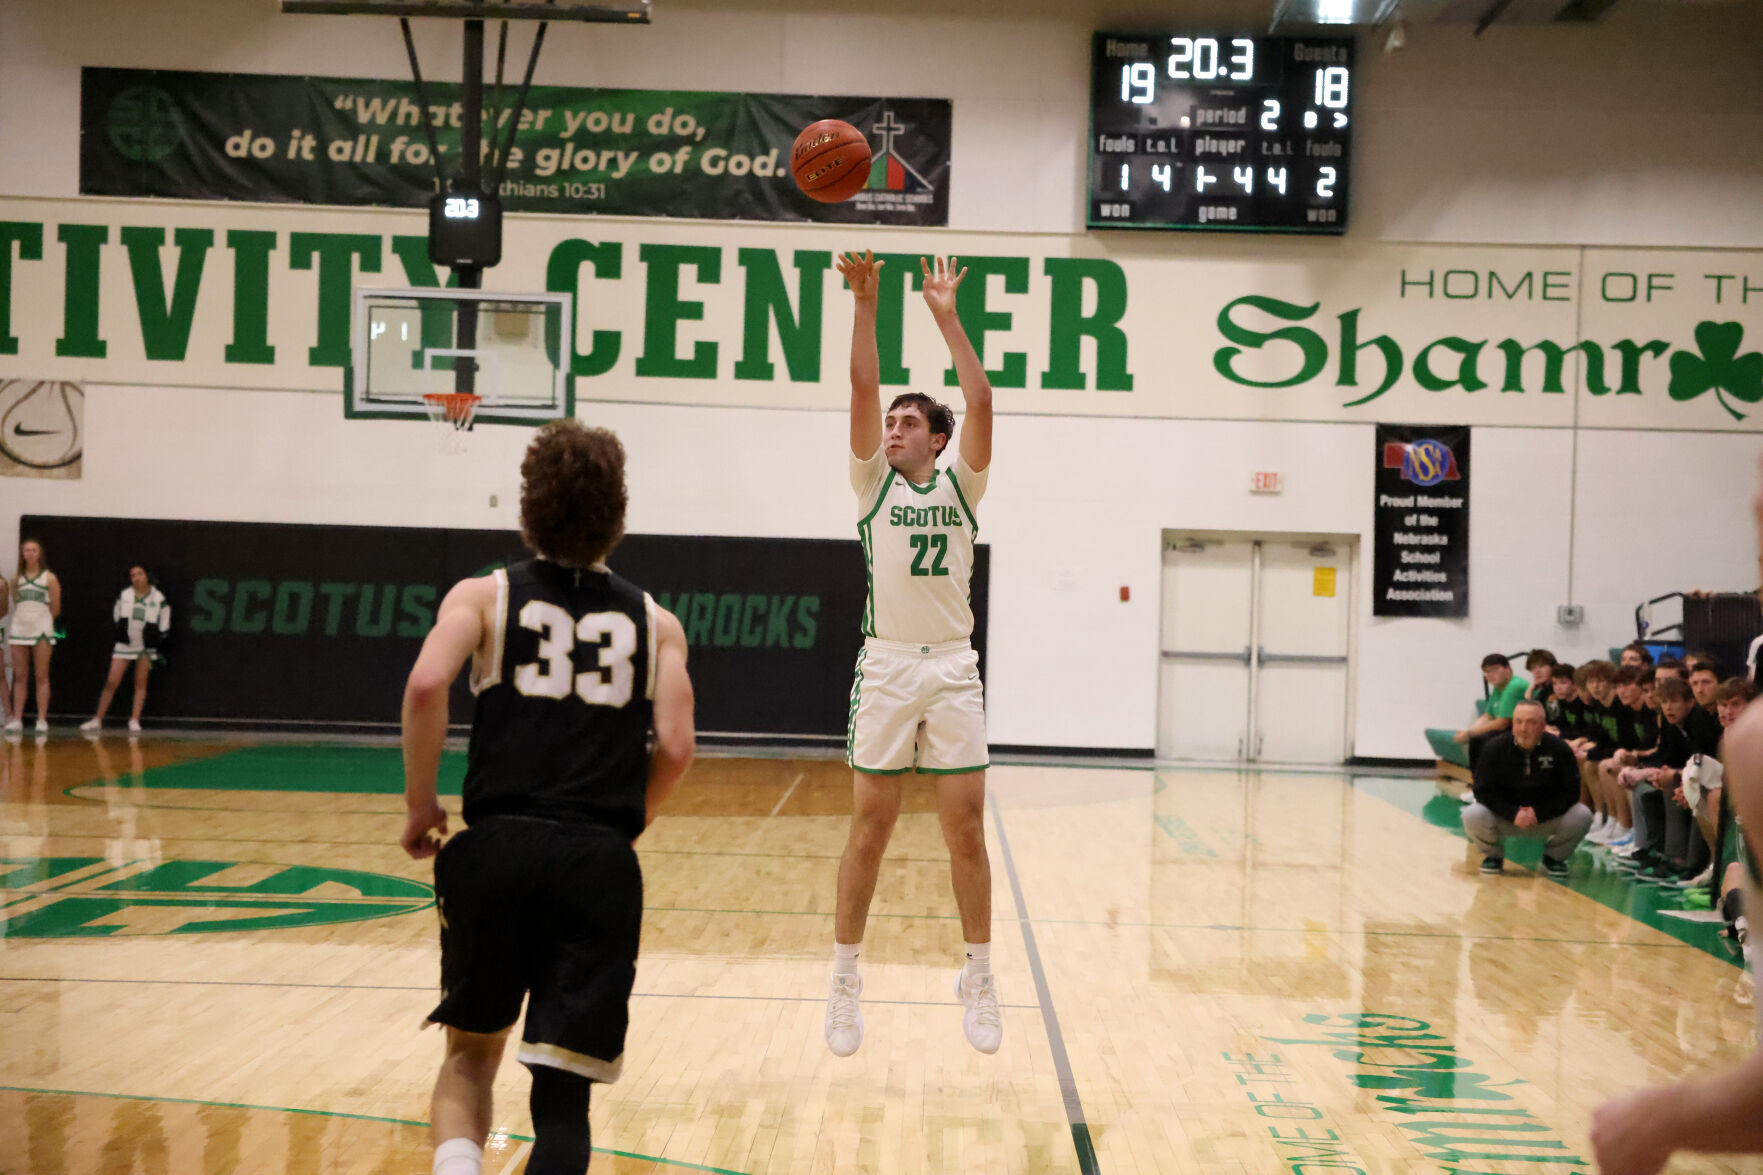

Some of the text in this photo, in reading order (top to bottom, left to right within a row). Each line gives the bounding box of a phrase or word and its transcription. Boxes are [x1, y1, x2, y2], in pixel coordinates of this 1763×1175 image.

[1168, 38, 1254, 80] 20.3
[1121, 63, 1155, 104] 19
[1315, 67, 1349, 108] 18
[560, 109, 635, 138] you
[647, 107, 706, 142] do,
[1196, 107, 1247, 126] period
[1261, 99, 1280, 130] 2
[224, 129, 275, 160] do
[287, 129, 316, 161] it
[327, 133, 379, 164] all
[534, 142, 639, 179] glory
[649, 146, 692, 174] of
[700, 147, 787, 178] God.
[1099, 134, 1135, 153] fouls
[1195, 135, 1246, 157] player
[1121, 163, 1129, 191] 1
[1152, 164, 1171, 192] 4
[1267, 167, 1287, 195] 4
[1316, 166, 1336, 198] 2
[564, 182, 605, 199] 10:31
[1100, 203, 1130, 218] won
[1198, 205, 1238, 224] game
[1306, 208, 1337, 223] won
[1401, 269, 1572, 301] HOME
[1602, 272, 1675, 303] OF
[1255, 472, 1278, 489] EXIT
[1379, 494, 1463, 509] Proud Member
[890, 505, 963, 527] SCOTUS
[1404, 514, 1439, 526] of the
[1393, 532, 1448, 546] Nebraska
[910, 533, 949, 577] 22
[1401, 551, 1440, 563] School
[1393, 569, 1447, 582] Activities
[1386, 588, 1453, 601] Association
[190, 577, 437, 639] SCOTUS
[513, 599, 637, 709] 33
